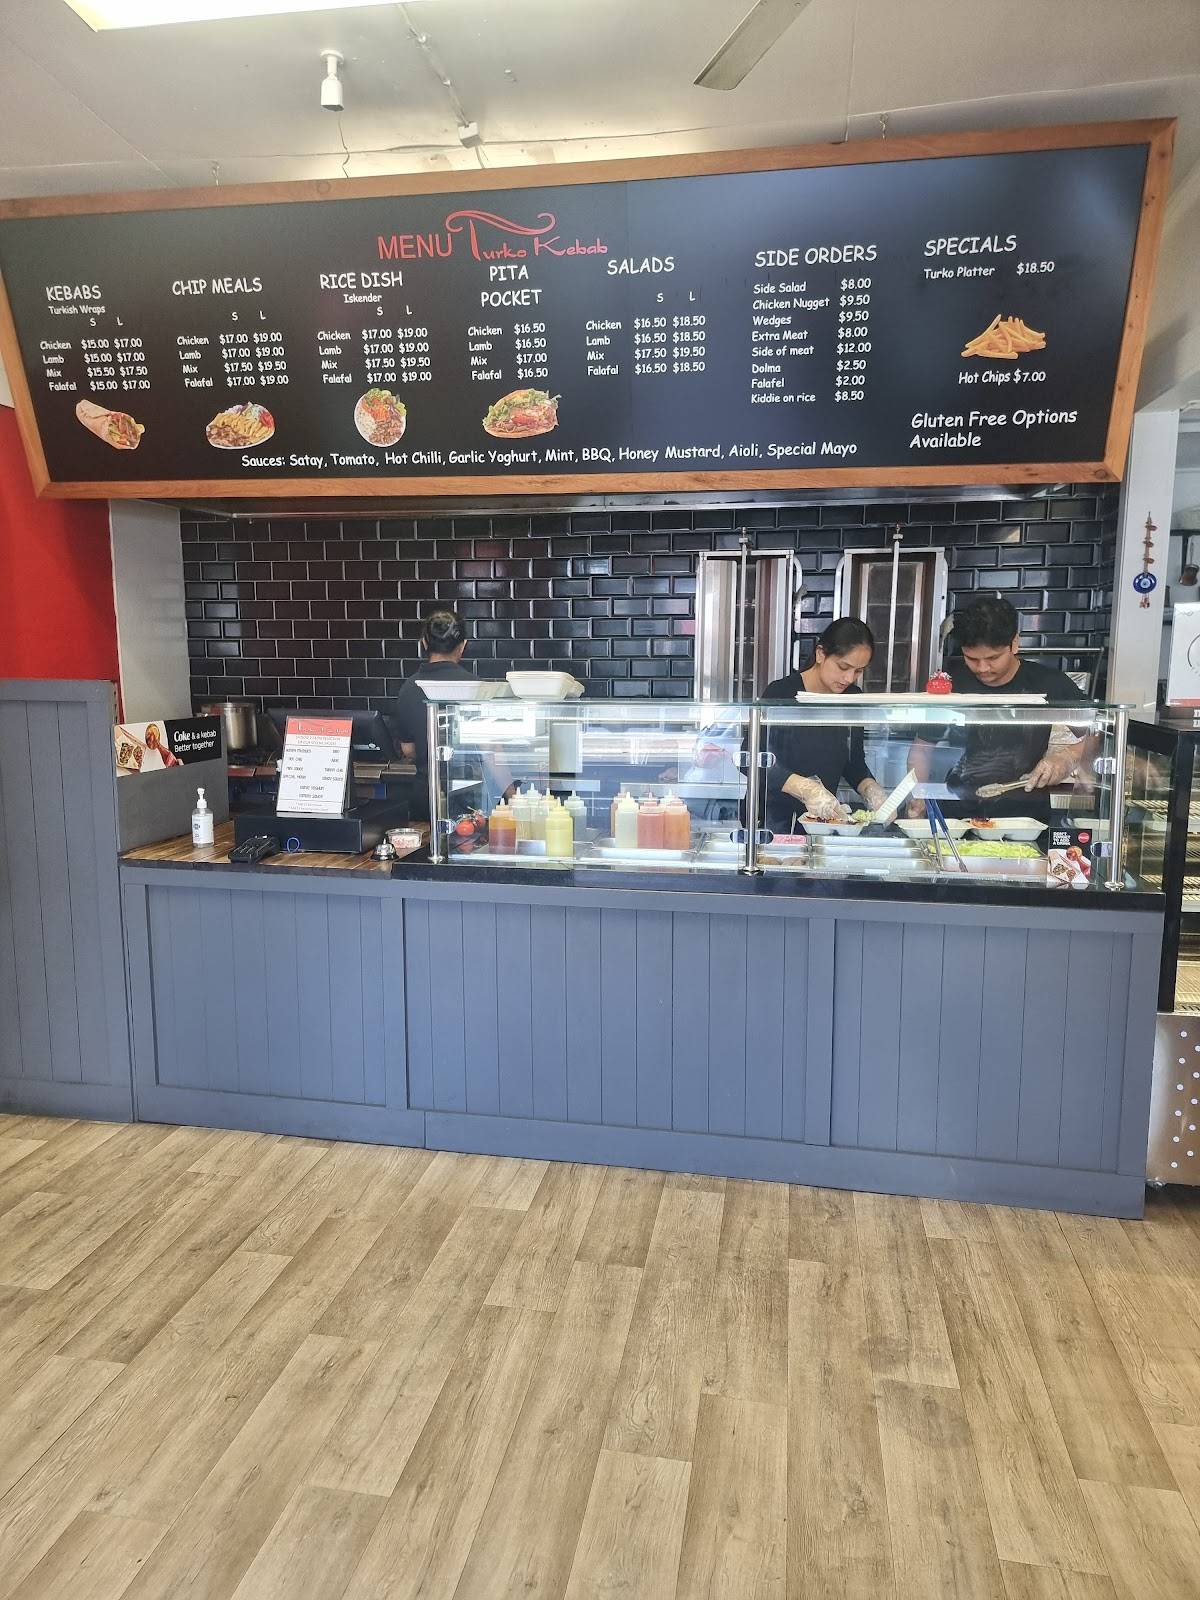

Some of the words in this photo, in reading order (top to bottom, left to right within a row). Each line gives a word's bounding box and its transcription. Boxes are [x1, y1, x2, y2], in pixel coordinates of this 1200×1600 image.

[378, 234, 452, 260] MENU
[532, 237, 608, 256] Kebab
[924, 235, 1016, 256] SPECIALS
[755, 248, 799, 267] SIDE
[805, 245, 877, 264] ORDERS
[607, 257, 674, 275] SALADS
[924, 268, 954, 279] Turko
[957, 267, 995, 277] Platter
[1017, 262, 1054, 275] $18.50
[490, 265, 528, 281] PITA
[172, 279, 207, 295] CHIP
[212, 277, 262, 293] MEALS
[320, 272, 356, 289] RICE
[361, 271, 402, 288] DISH
[754, 283, 775, 294] Side
[779, 282, 806, 292] Salad
[841, 278, 871, 291] $8.00
[46, 285, 101, 301] KEBABS
[344, 293, 382, 303] Iskender
[481, 289, 542, 307] POCKET
[657, 293, 663, 302] S
[690, 292, 695, 301] L
[753, 299, 790, 309] Chicken
[794, 298, 830, 310] Nugget
[840, 294, 870, 307] $9.50
[48, 306, 78, 314] Turkish
[79, 305, 105, 315] Wraps
[232, 312, 238, 320] S
[260, 311, 266, 319] L
[377, 307, 383, 315] S
[406, 305, 412, 315] L
[90, 318, 96, 326] S
[117, 317, 123, 325] L
[586, 320, 621, 330] Chicken
[634, 317, 666, 330] $16.50
[673, 316, 705, 328] $18.50
[753, 315, 791, 327] Wedges
[839, 311, 869, 323] $9.50
[317, 331, 351, 340] Chicken
[362, 329, 392, 341] $17.00
[398, 328, 427, 339] $19.00
[468, 326, 502, 336] Chicken
[514, 323, 545, 335] $16.50
[752, 331, 780, 341] Extra
[783, 330, 808, 340] Meat
[838, 327, 868, 339] $8.00
[40, 341, 71, 349] Chicken
[81, 339, 109, 350] $15.00
[114, 338, 142, 349] $17.00
[177, 336, 209, 345] Chicken
[220, 334, 248, 345] $17.00
[253, 332, 282, 344] $19.00
[469, 341, 492, 351] Lamb
[515, 338, 546, 350] $16.50
[587, 335, 610, 345] Lamb
[634, 333, 666, 345] $16.50
[673, 331, 705, 343] $18.50
[179, 350, 201, 359] Lamb
[222, 348, 250, 359] $17.00
[256, 347, 284, 358] $19.00
[319, 345, 341, 355] Lamb
[364, 344, 393, 355] $17.00
[399, 343, 429, 354] $19.00
[587, 351, 604, 360] Mix
[635, 348, 666, 360] $17.50
[673, 347, 705, 358] $19.50
[752, 346, 773, 356] Side
[776, 345, 787, 356] of
[789, 345, 814, 356] meat
[837, 342, 871, 355] $12.00
[43, 355, 64, 364] Lamb
[84, 353, 112, 364] $15.00
[117, 352, 145, 363] $17.00
[322, 360, 337, 369] Mix
[365, 358, 395, 369] $17.50
[401, 357, 430, 368] $19.50
[471, 356, 487, 365] Mix
[516, 353, 547, 365] $17.00
[47, 369, 61, 377] Mix
[87, 367, 115, 377] $15.50
[120, 366, 147, 377] $17.50
[183, 365, 198, 373] Mix
[224, 362, 253, 373] $17.50
[258, 361, 286, 372] $19.50
[588, 365, 618, 375] Falafal
[635, 363, 667, 375] $16.50
[673, 362, 705, 373] $18.50
[752, 363, 780, 373] Dolma
[837, 360, 866, 372] $2.50
[323, 374, 352, 383] Falafal
[367, 373, 396, 384] $17.00
[402, 372, 431, 383] $19.00
[472, 370, 501, 380] Falafal
[518, 368, 548, 379] $16.50
[959, 372, 979, 384] Hot
[982, 371, 1010, 385] Chips
[1013, 368, 1046, 383] $7.00
[49, 382, 76, 391] Falafal
[90, 381, 117, 391] $15.00
[122, 380, 150, 391] $17.00
[185, 378, 213, 387] Falafal
[227, 376, 255, 387] $17.00
[260, 375, 289, 386] $19.00
[752, 378, 784, 388] Falafel
[836, 375, 865, 387] $2.00
[751, 393, 780, 403] Kiddie
[797, 393, 815, 401] rice
[835, 391, 864, 402] $8.50
[912, 413, 963, 428] Gluten
[969, 411, 1007, 426] Free
[1013, 409, 1077, 428] Options
[910, 432, 981, 448] Available
[242, 455, 285, 466] Sauces:
[290, 454, 327, 469] Satay,
[330, 454, 379, 466] Tomato,
[385, 452, 408, 464] Hot
[412, 451, 445, 465] Chilli,
[449, 450, 485, 463] Garlic
[488, 450, 541, 466] Yoghurt,
[546, 449, 578, 462] Mint,
[583, 448, 615, 462] BBQ,
[619, 447, 659, 462] Honey
[665, 444, 724, 459] Mustard,
[729, 443, 762, 458] Aioli,
[767, 442, 816, 459] Special
[821, 442, 857, 457] Mayo
[174, 730, 191, 742] Coke
[201, 730, 217, 738] kebab
[174, 744, 191, 753] Better
[192, 740, 214, 750] together
